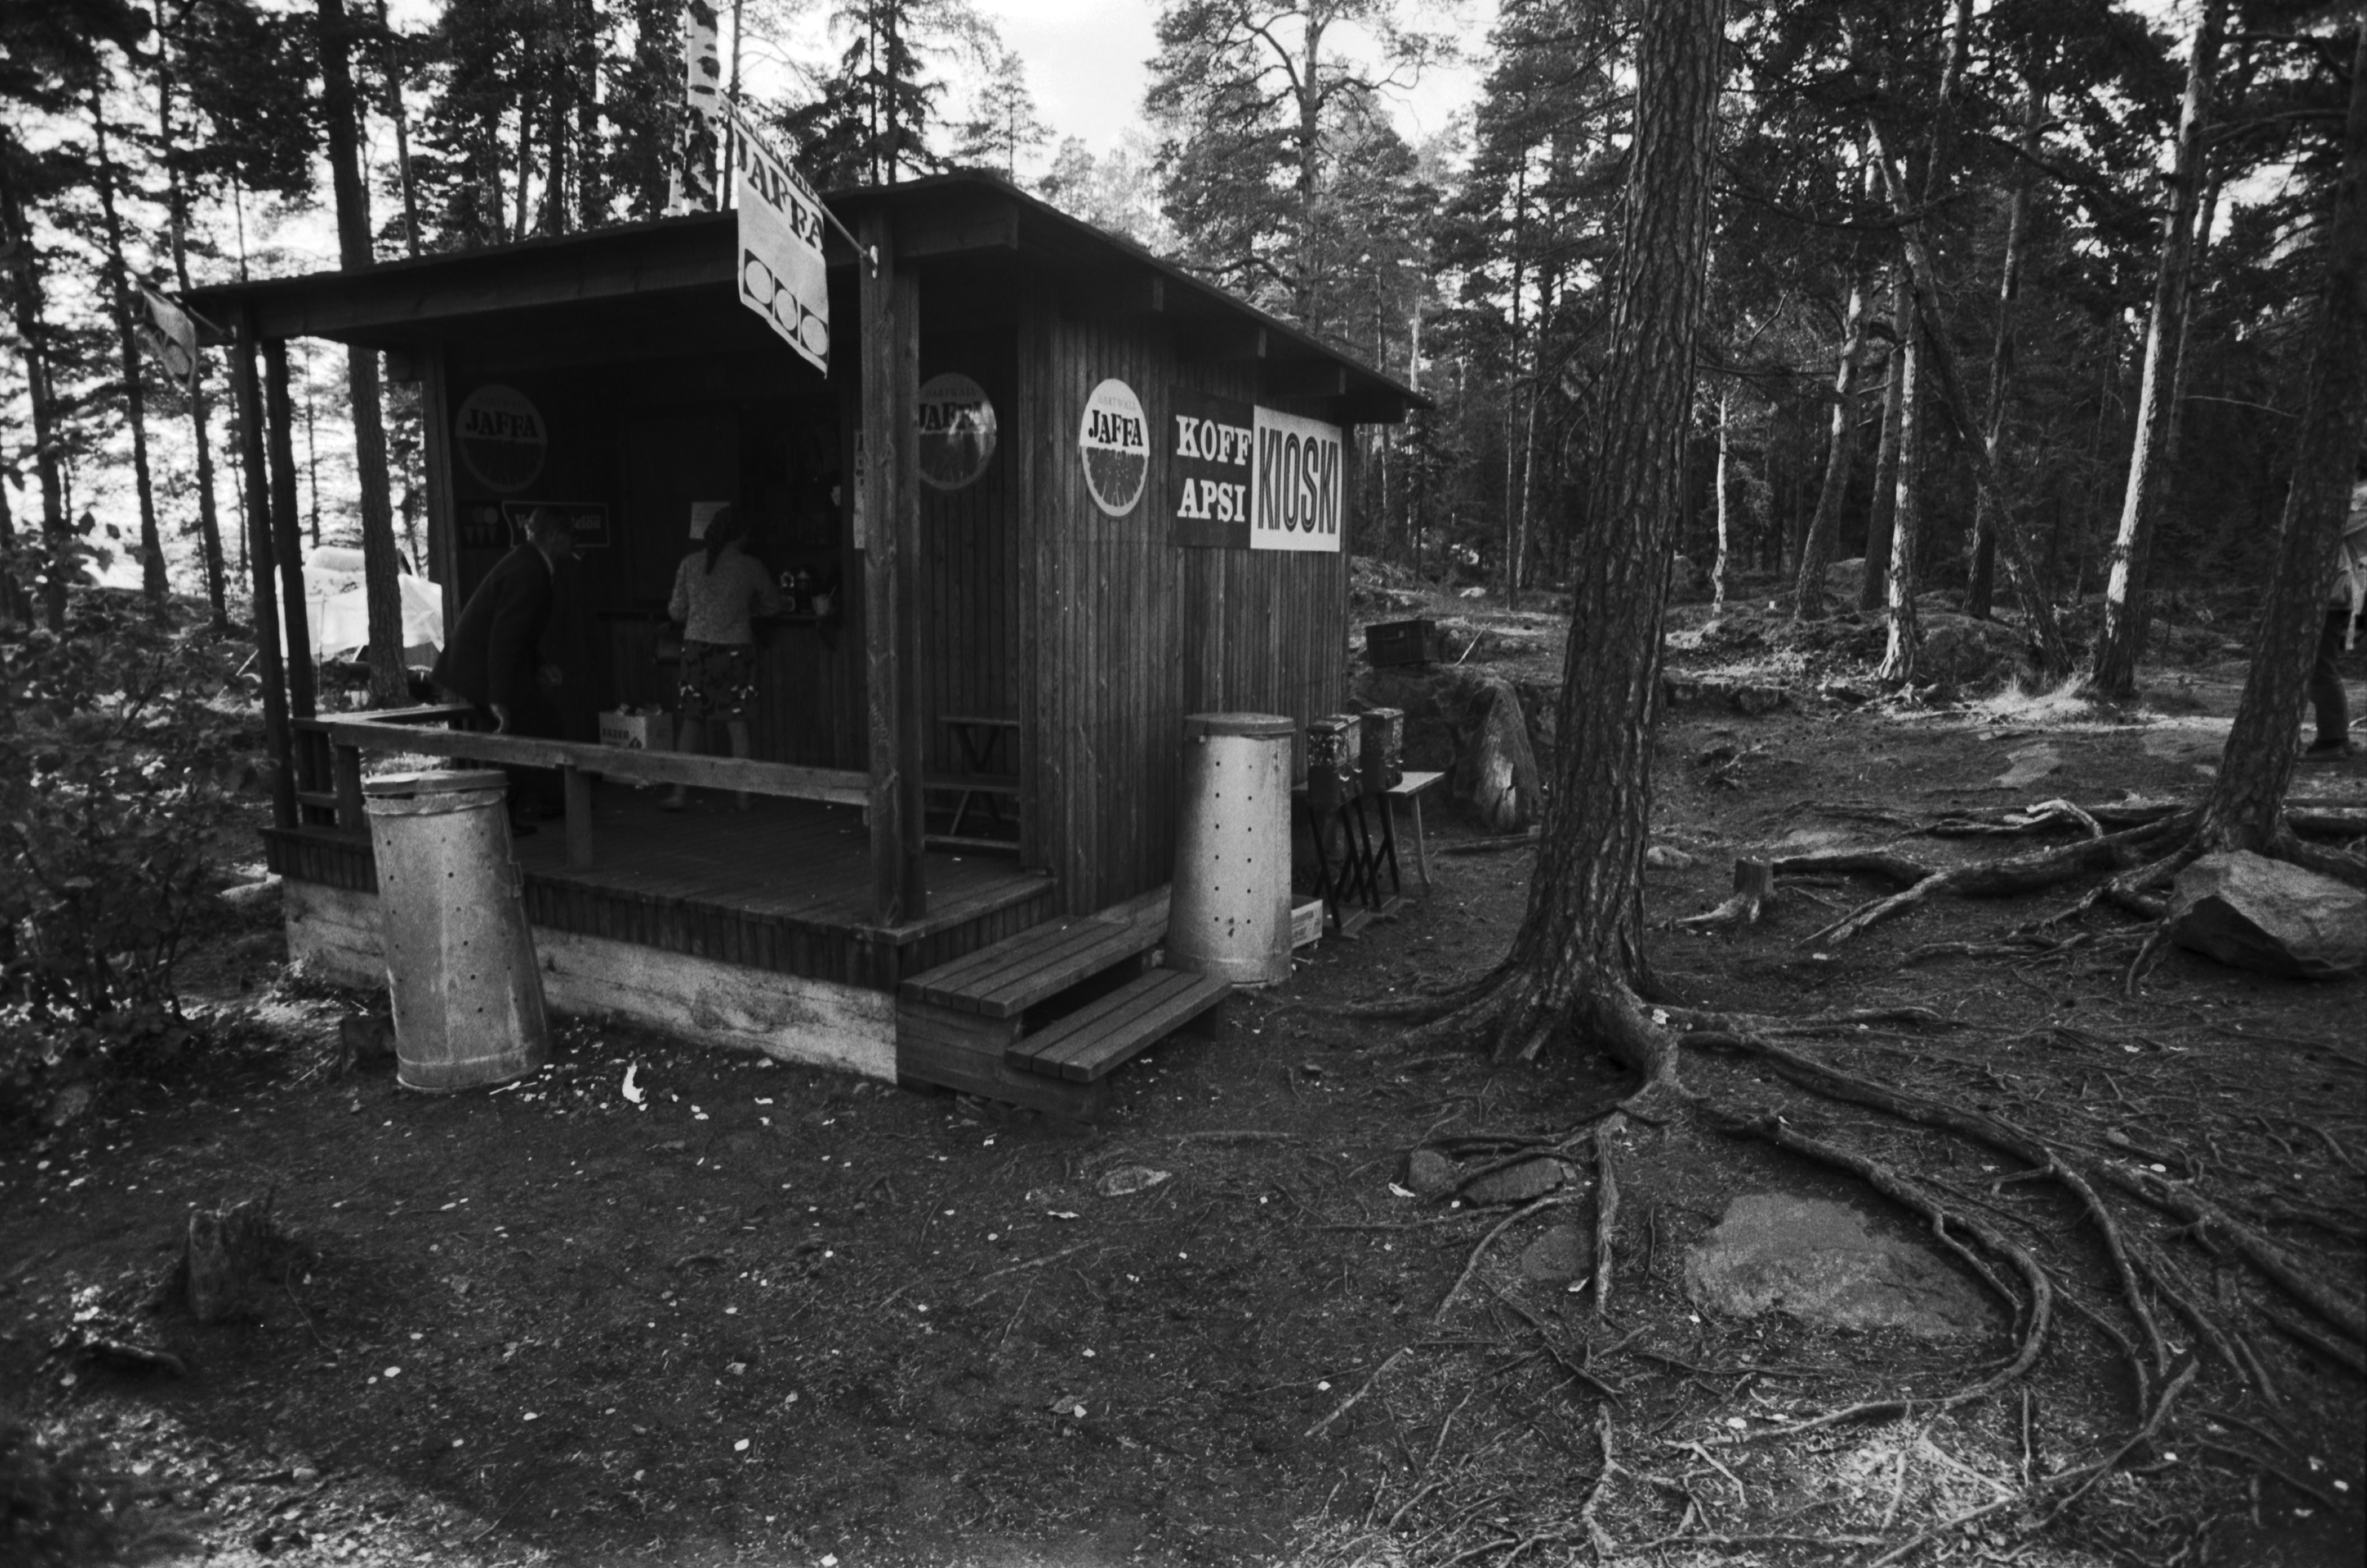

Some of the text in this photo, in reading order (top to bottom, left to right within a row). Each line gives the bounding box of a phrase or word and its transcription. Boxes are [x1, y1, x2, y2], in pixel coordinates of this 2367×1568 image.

[735, 129, 824, 251] JAFFA
[465, 409, 539, 438] JAFFA
[1088, 409, 1143, 447] JAFFA
[1176, 415, 1252, 465] KOFF
[1177, 478, 1246, 522] APSI
[1258, 426, 1338, 534] KIOSKI
